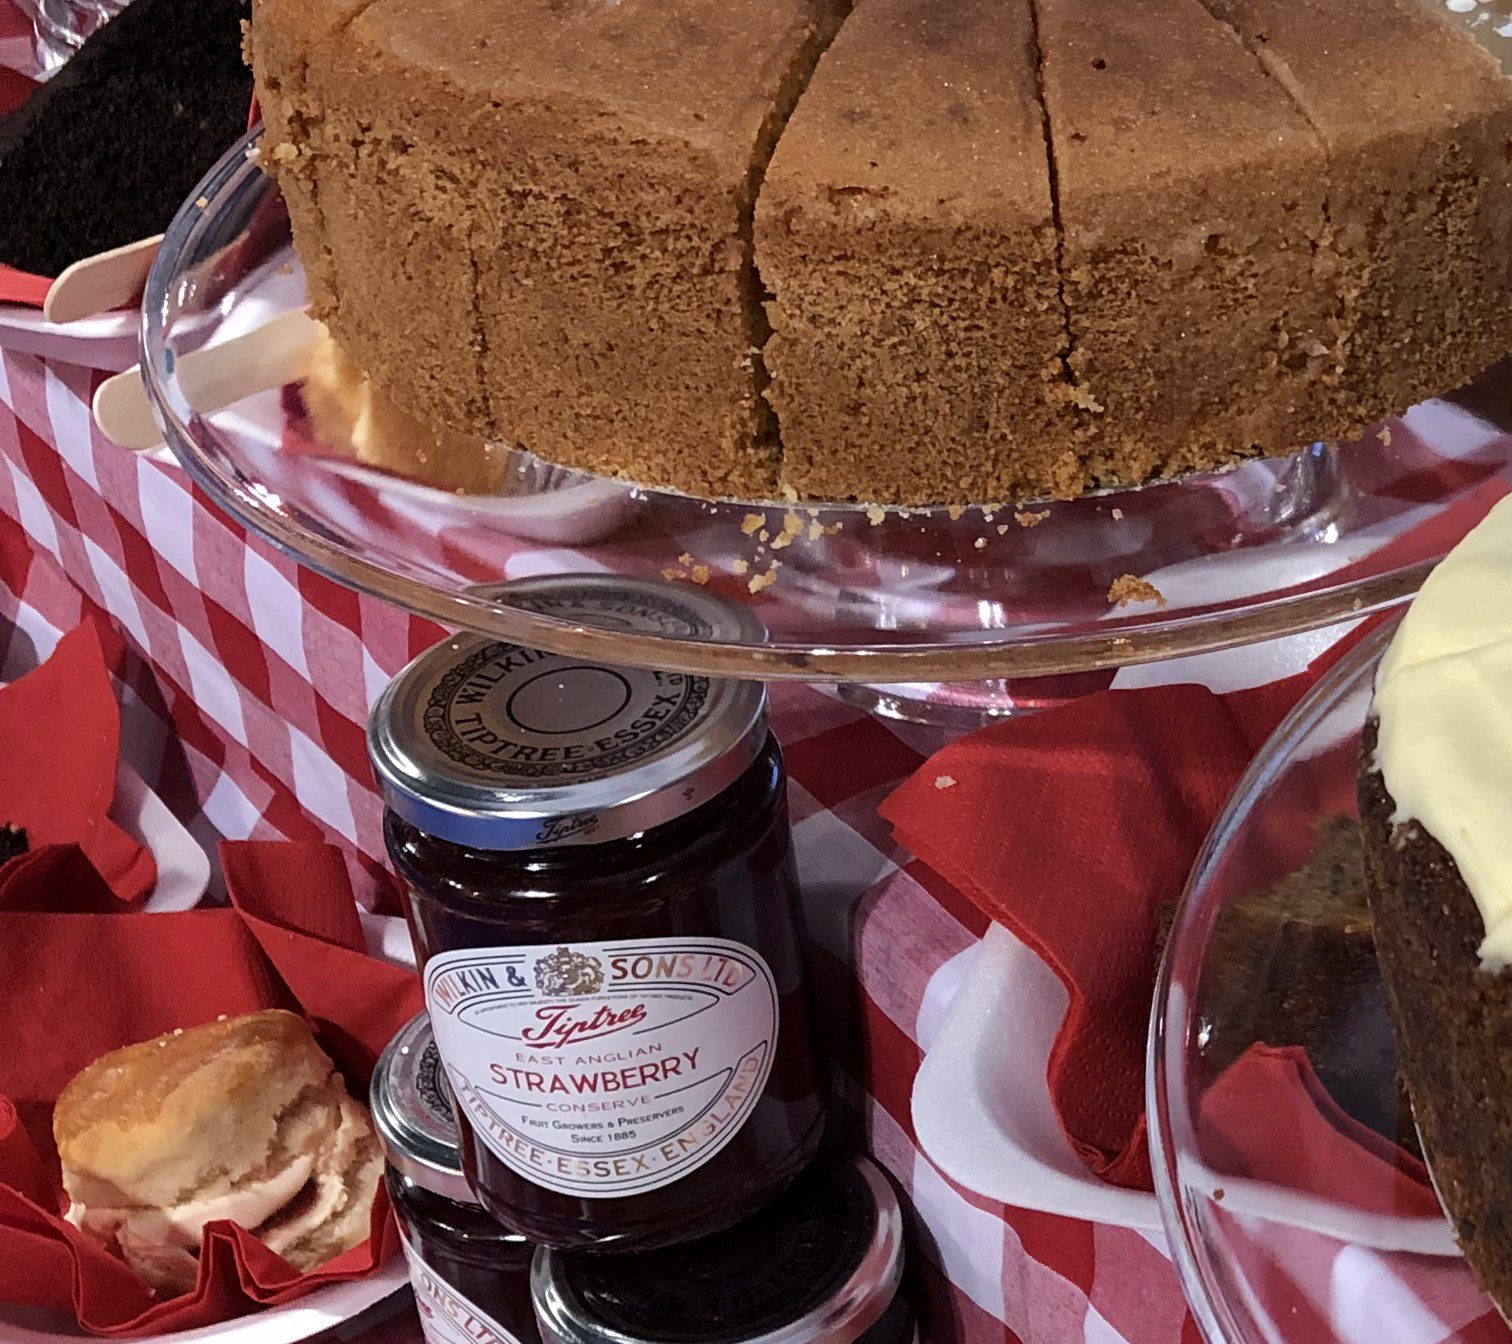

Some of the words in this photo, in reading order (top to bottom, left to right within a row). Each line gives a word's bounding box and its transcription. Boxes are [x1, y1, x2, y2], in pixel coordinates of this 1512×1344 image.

[454, 711, 583, 762] TIPTREE
[592, 692, 681, 755] ESSEX
[536, 813, 599, 844] Tiptree
[434, 967, 500, 1009] WILKIN
[505, 965, 528, 987] &
[610, 954, 696, 981] SONS
[702, 955, 744, 988] LTD
[521, 1002, 648, 1050] Tiptree
[489, 1046, 700, 1095] STRAWBERRY
[515, 1052, 565, 1066] EAST
[574, 1042, 662, 1066] ANGLIAN
[461, 1080, 550, 1165] TIPTREE
[557, 1153, 651, 1178] ESSEX
[660, 1056, 759, 1162] ENGLAND
[545, 1094, 651, 1113] CONSERVE
[606, 1121, 615, 1129] &
[607, 1130, 637, 1142] 1885
[419, 1271, 460, 1318] ONS
